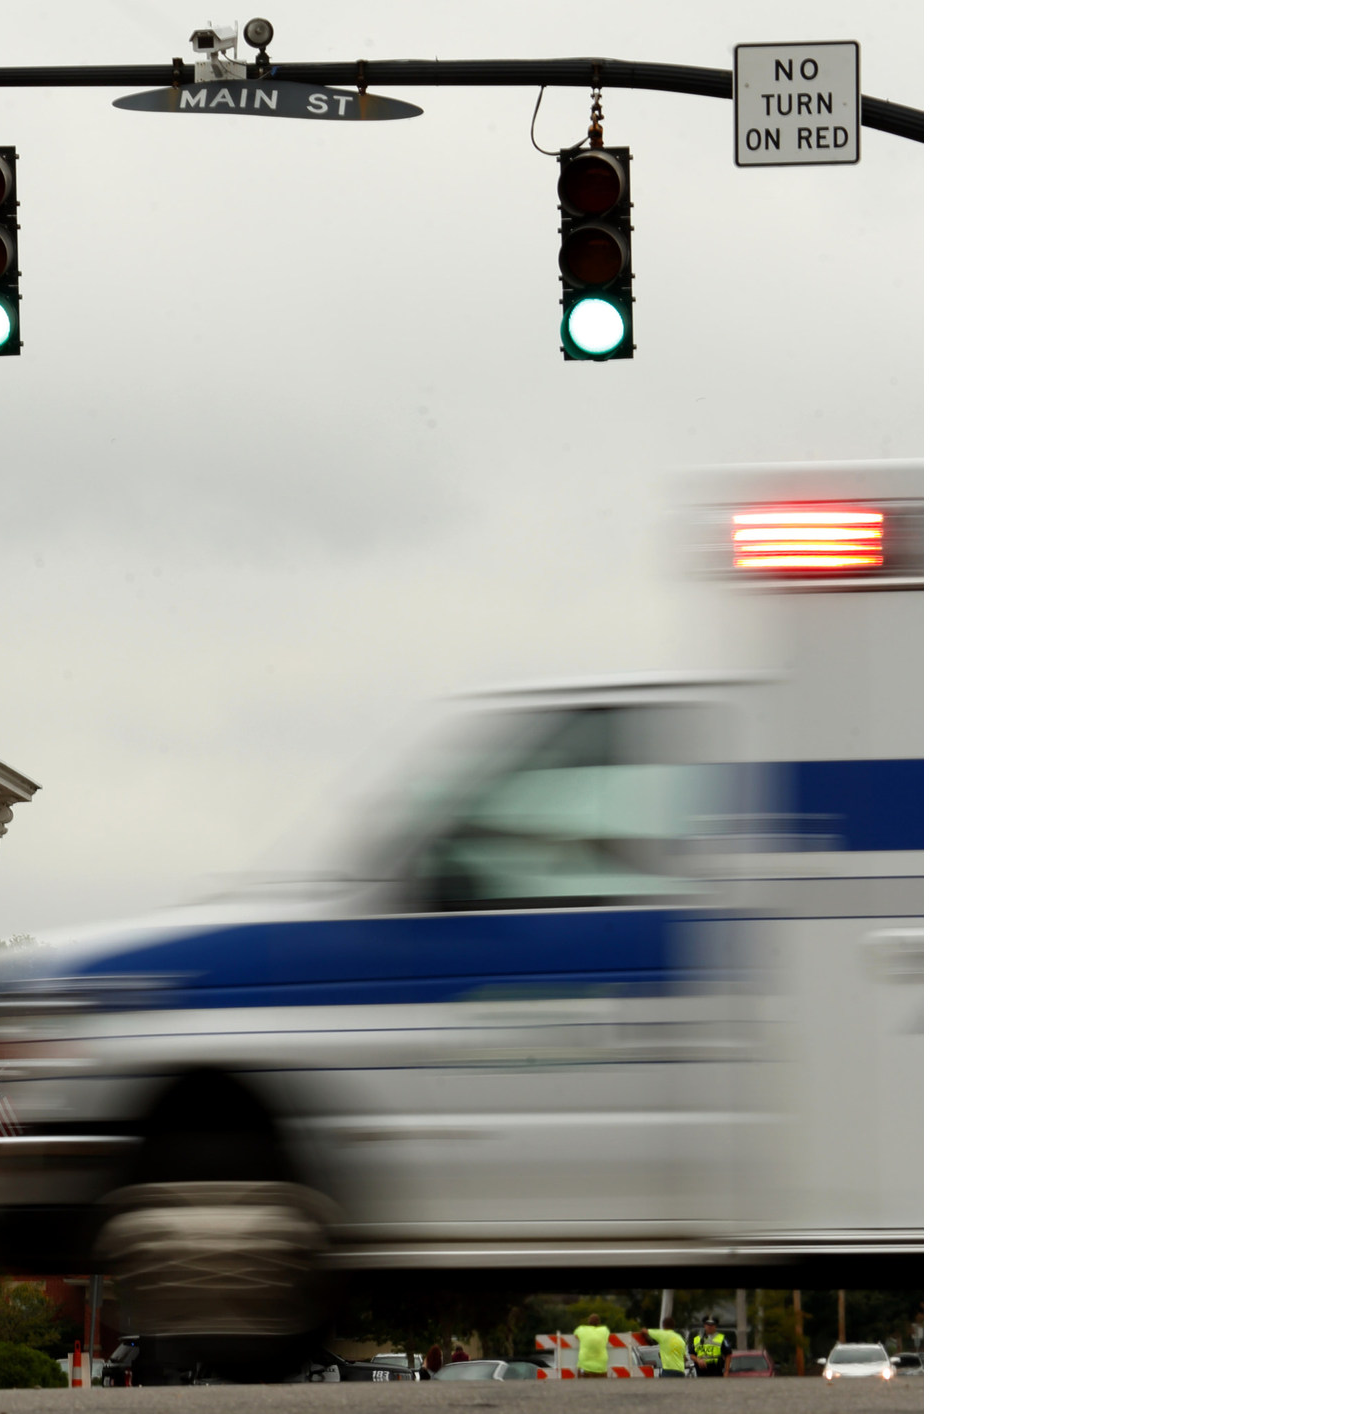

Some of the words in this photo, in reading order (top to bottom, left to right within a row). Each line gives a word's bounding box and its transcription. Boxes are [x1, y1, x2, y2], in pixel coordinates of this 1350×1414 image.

[774, 57, 819, 81] NO
[179, 87, 279, 110] MAIN
[306, 93, 354, 116] ST
[761, 91, 833, 116] TURN
[745, 127, 781, 151] ON
[797, 125, 849, 149] RED
